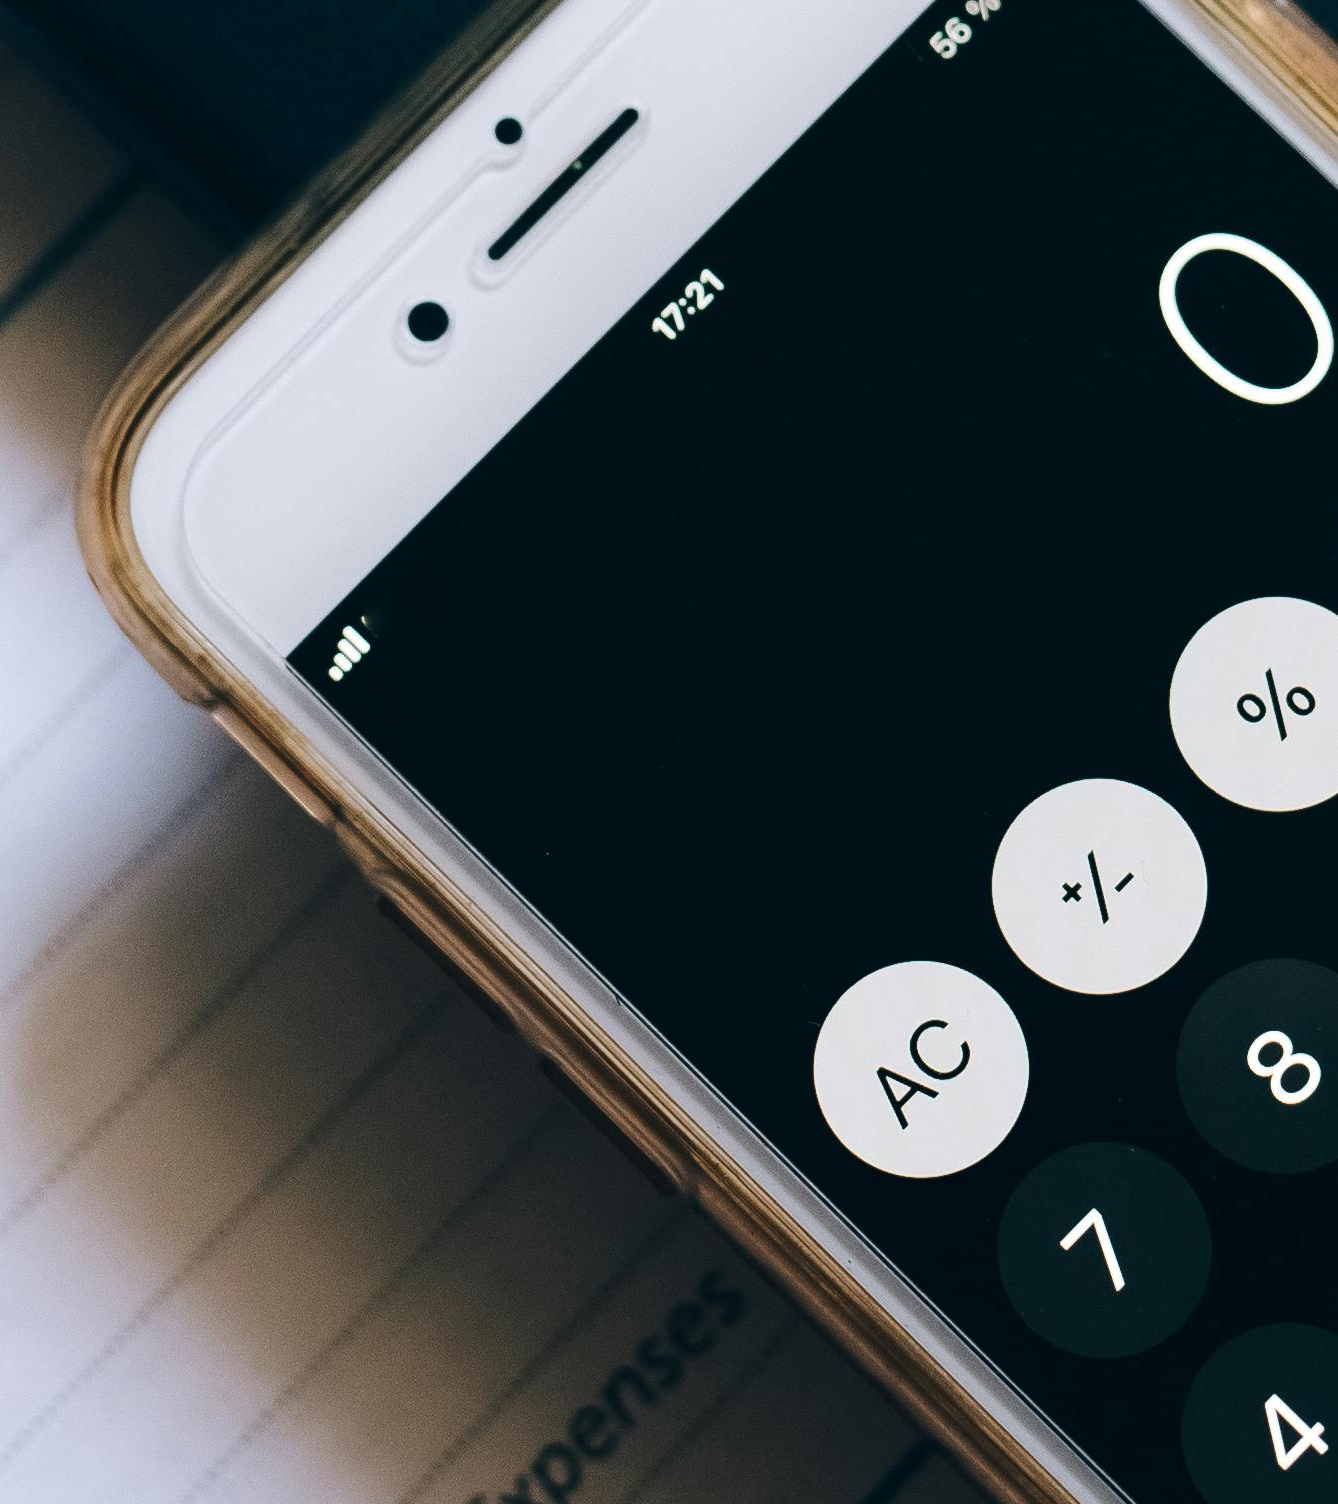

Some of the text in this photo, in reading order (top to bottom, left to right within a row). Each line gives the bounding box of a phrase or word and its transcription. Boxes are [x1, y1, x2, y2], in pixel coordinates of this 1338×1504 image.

[927, 16, 977, 61] 56
[650, 267, 726, 341] 17:21
[1158, 232, 1335, 405] 0
[877, 1020, 970, 1129] AC
[1247, 1031, 1321, 1104] 8
[1060, 1208, 1125, 1291] 7
[1265, 1394, 1328, 1470] 4
